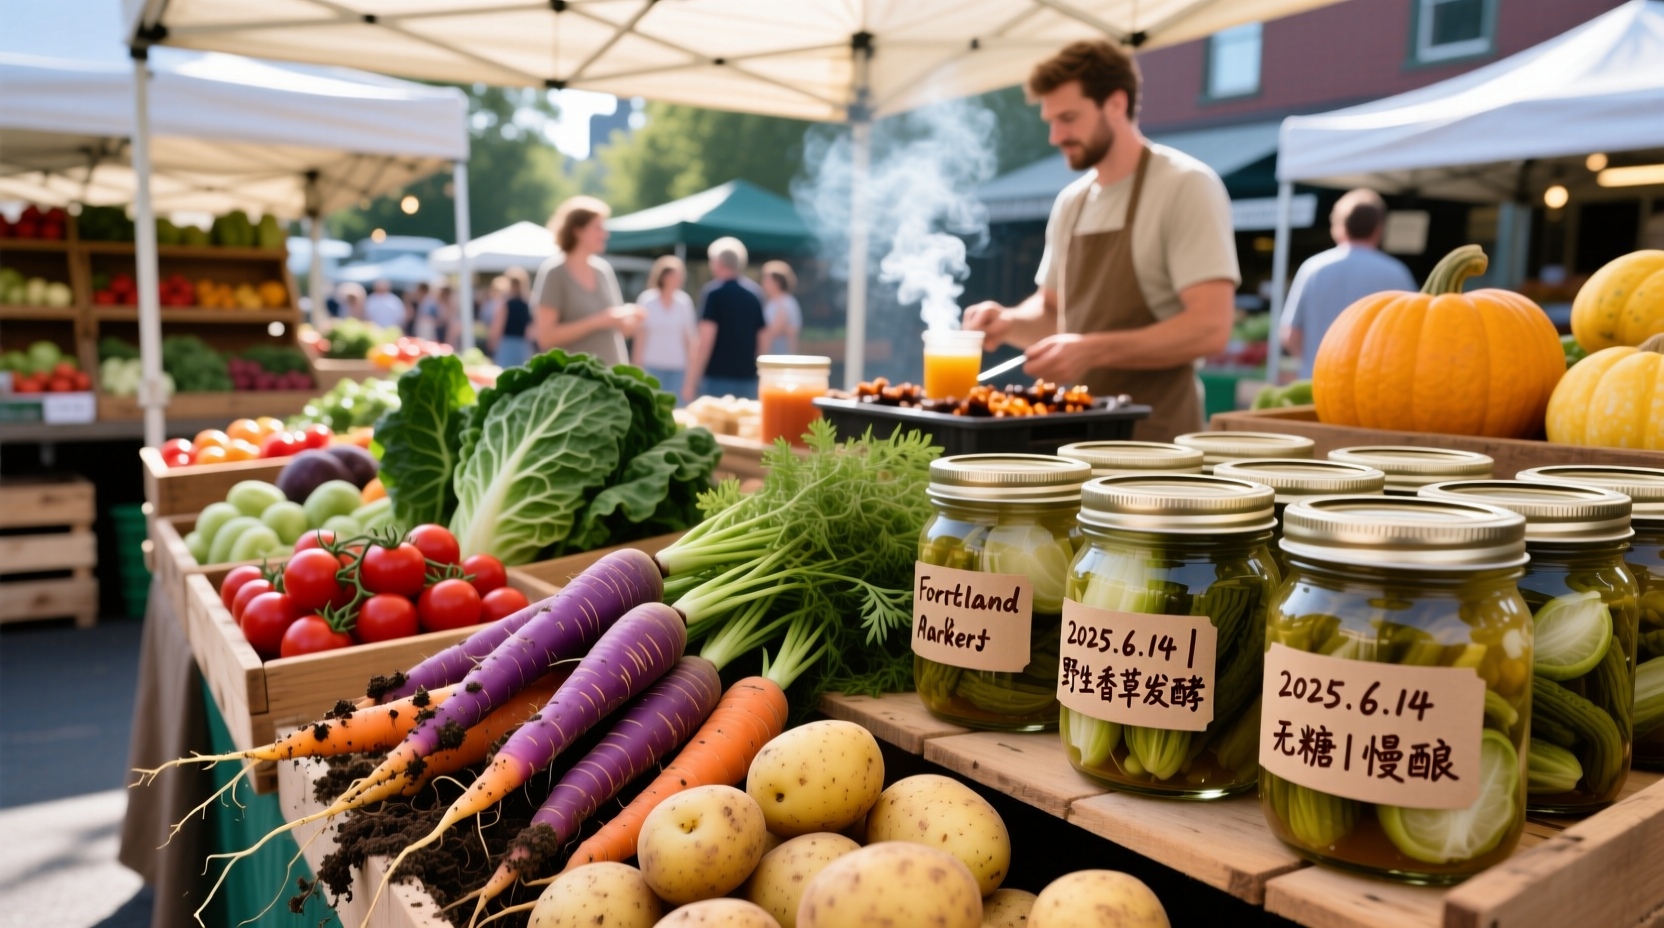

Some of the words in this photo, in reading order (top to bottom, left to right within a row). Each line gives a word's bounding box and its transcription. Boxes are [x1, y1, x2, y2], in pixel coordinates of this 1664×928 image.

[1067, 620, 1178, 662] 2025.6.14
[1061, 656, 1206, 713] 野生香草发酵
[1278, 670, 1435, 722] 2025.6.14
